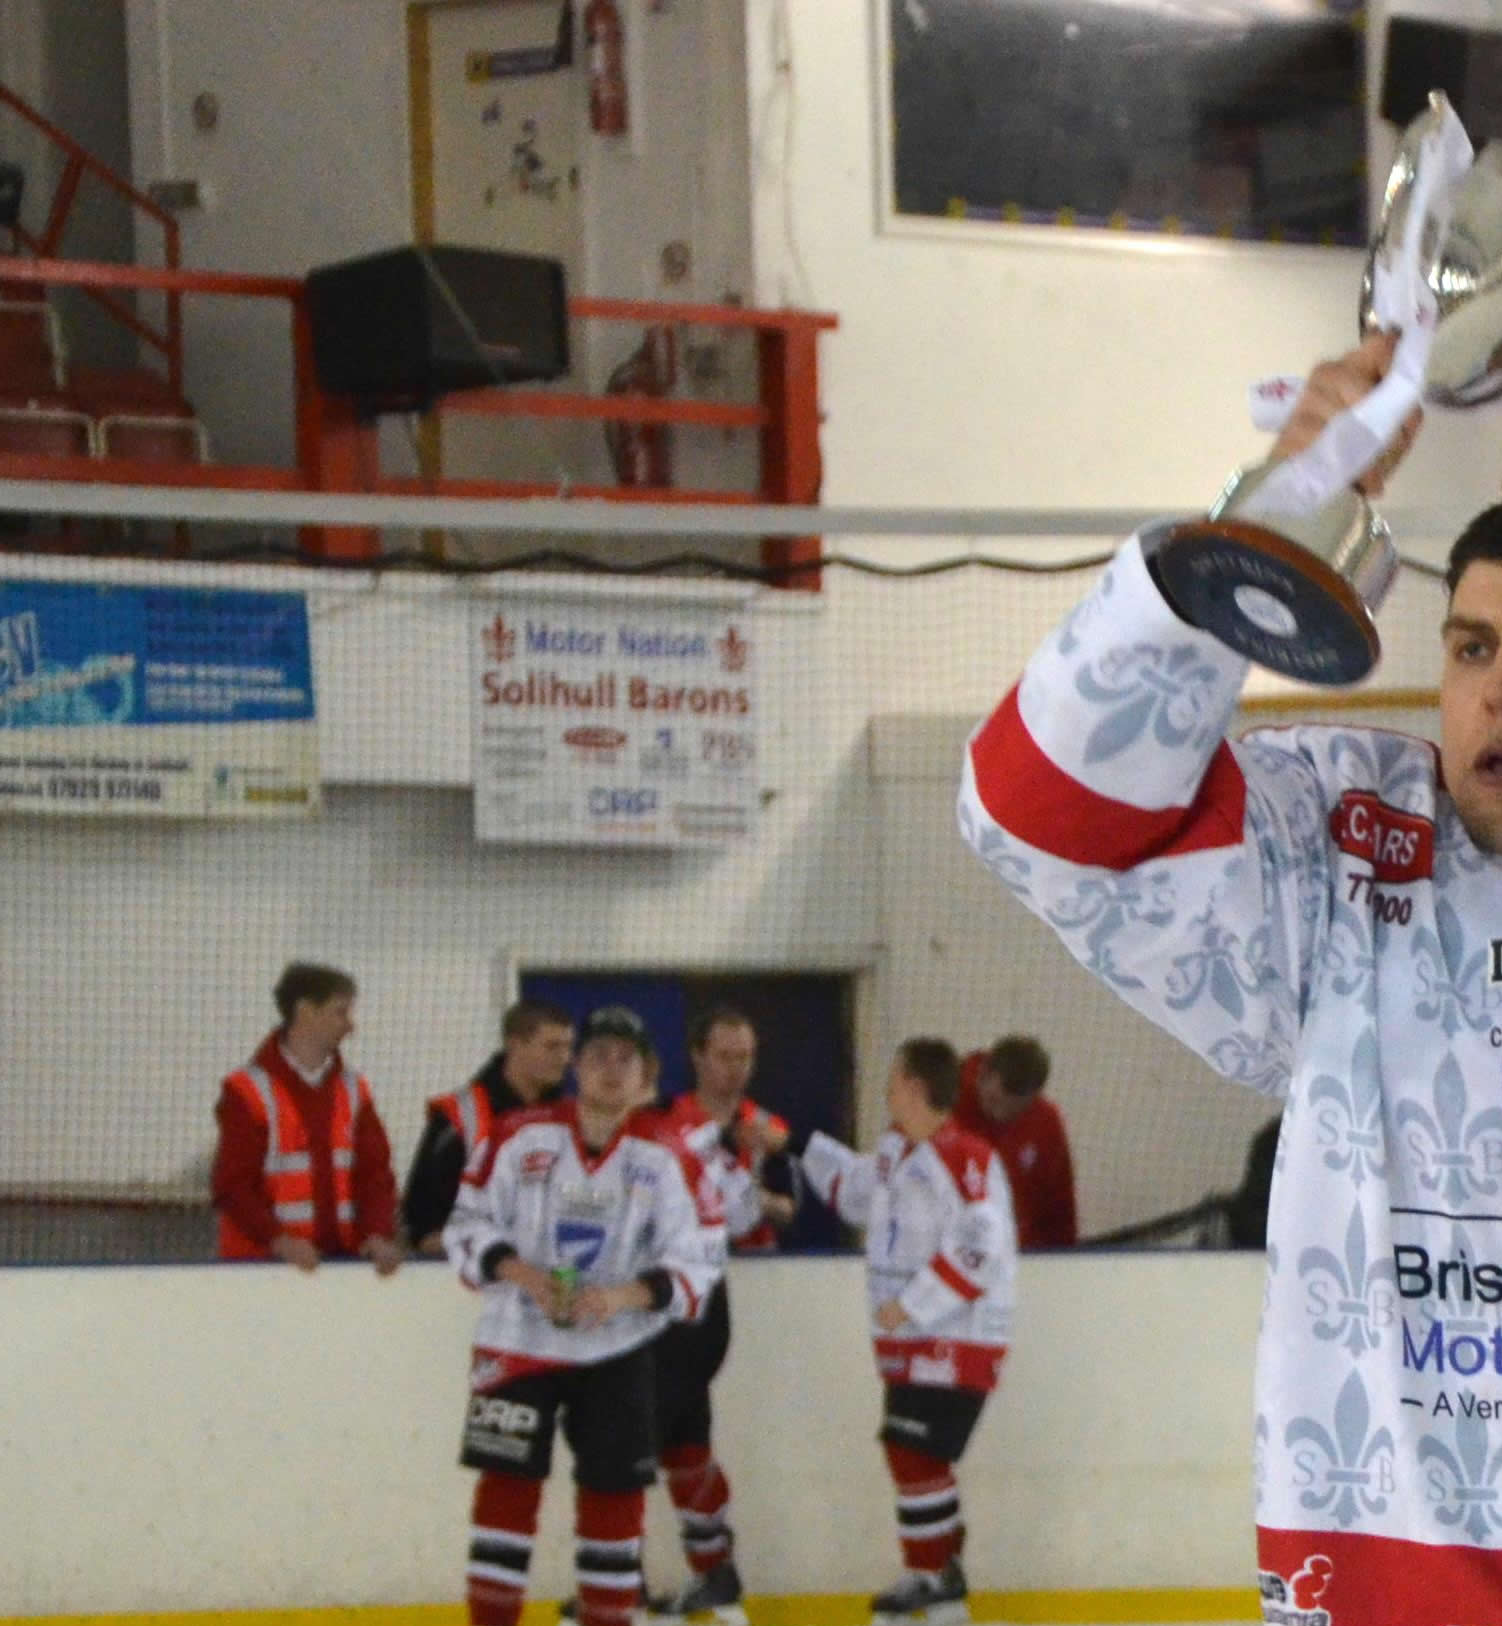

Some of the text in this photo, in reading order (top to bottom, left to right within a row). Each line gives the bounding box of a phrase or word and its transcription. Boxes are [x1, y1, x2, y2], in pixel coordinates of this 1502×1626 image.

[526, 620, 706, 659] Motor Nation
[482, 671, 750, 713] Solihull Barons
[1432, 1392, 1456, 1418] A
